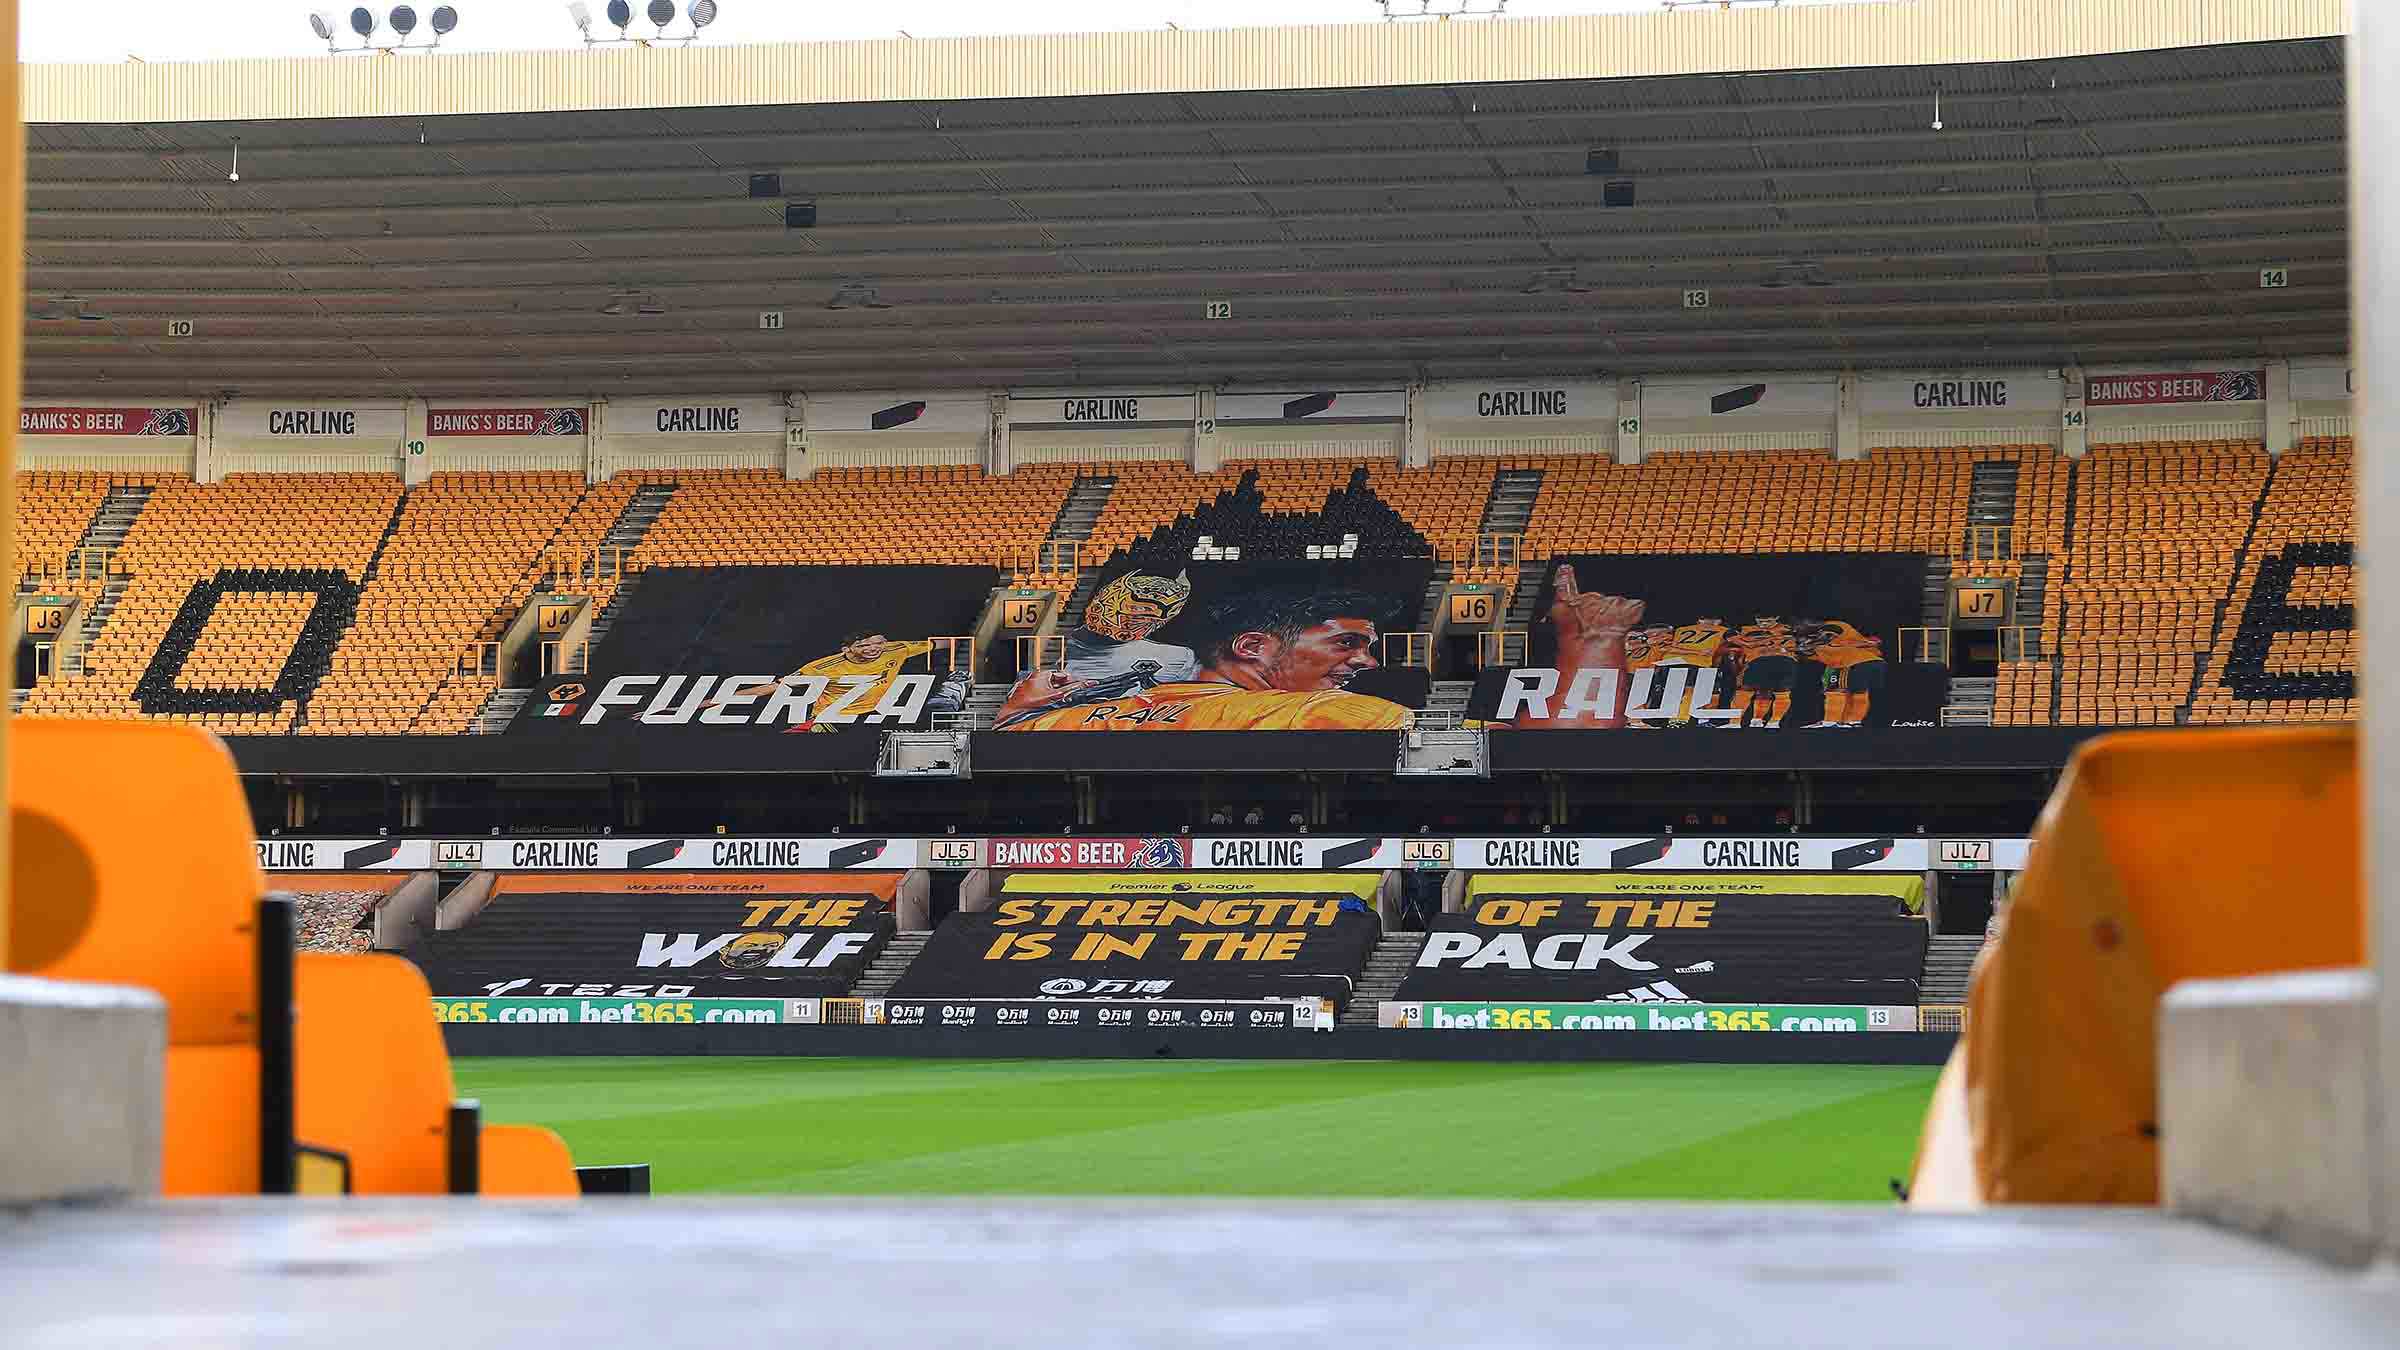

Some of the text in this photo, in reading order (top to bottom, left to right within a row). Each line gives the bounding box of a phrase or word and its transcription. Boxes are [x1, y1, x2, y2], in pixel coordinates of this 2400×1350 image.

[2263, 271, 2284, 287] 14
[1687, 291, 1706, 306] 13
[1208, 302, 1229, 318] 12
[171, 321, 190, 335] 10
[764, 313, 780, 327] 11
[1914, 381, 2007, 407] CARLING
[2161, 379, 2204, 398] BEER
[1064, 399, 1138, 421] CARLING
[1478, 390, 1567, 416] CARLING
[86, 413, 124, 430] BEER
[269, 410, 355, 435] CARLING
[496, 414, 534, 431] BEER
[656, 407, 739, 432] CARLING
[1197, 419, 1214, 434] 12
[1620, 419, 1638, 434] 13
[2064, 411, 2083, 425] 14
[790, 428, 804, 442] 11
[407, 440, 425, 455] 10
[1460, 598, 1486, 618] J6
[1969, 593, 1994, 613] J7
[37, 610, 61, 628] J3
[547, 610, 570, 628] J4
[1013, 604, 1038, 623] J5
[1680, 630, 1717, 645] 27
[580, 674, 935, 725] FUERZA
[1495, 667, 1745, 720] RAUL
[1891, 718, 1935, 728] Louise
[256, 842, 314, 867] RLING
[445, 844, 475, 860] JL4
[512, 841, 599, 867] CARLING
[712, 841, 800, 866] CARLING
[938, 843, 969, 859] JL5
[1077, 841, 1125, 864] BEER
[1211, 840, 1303, 867] CARLING
[1410, 843, 1443, 859] JL6
[1485, 840, 1580, 866] CARLING
[1702, 840, 1800, 867] CARLING
[1951, 843, 1982, 859] JL7
[1197, 883, 1256, 891] League
[741, 899, 869, 927] THE
[992, 899, 1343, 927] STRENGTH
[1475, 899, 1716, 928] OF THE
[983, 932, 1308, 961] IS IN THE
[1415, 932, 1660, 971] PACK
[540, 983, 696, 997] TEZO
[431, 1000, 777, 1023] 365.com bet365.com
[794, 1004, 809, 1017] 11
[1296, 1006, 1312, 1018] 12
[1402, 1008, 1418, 1019] 13
[1433, 1007, 1857, 1031] bet365.com bet365.com
[1871, 1011, 1887, 1023] 13
